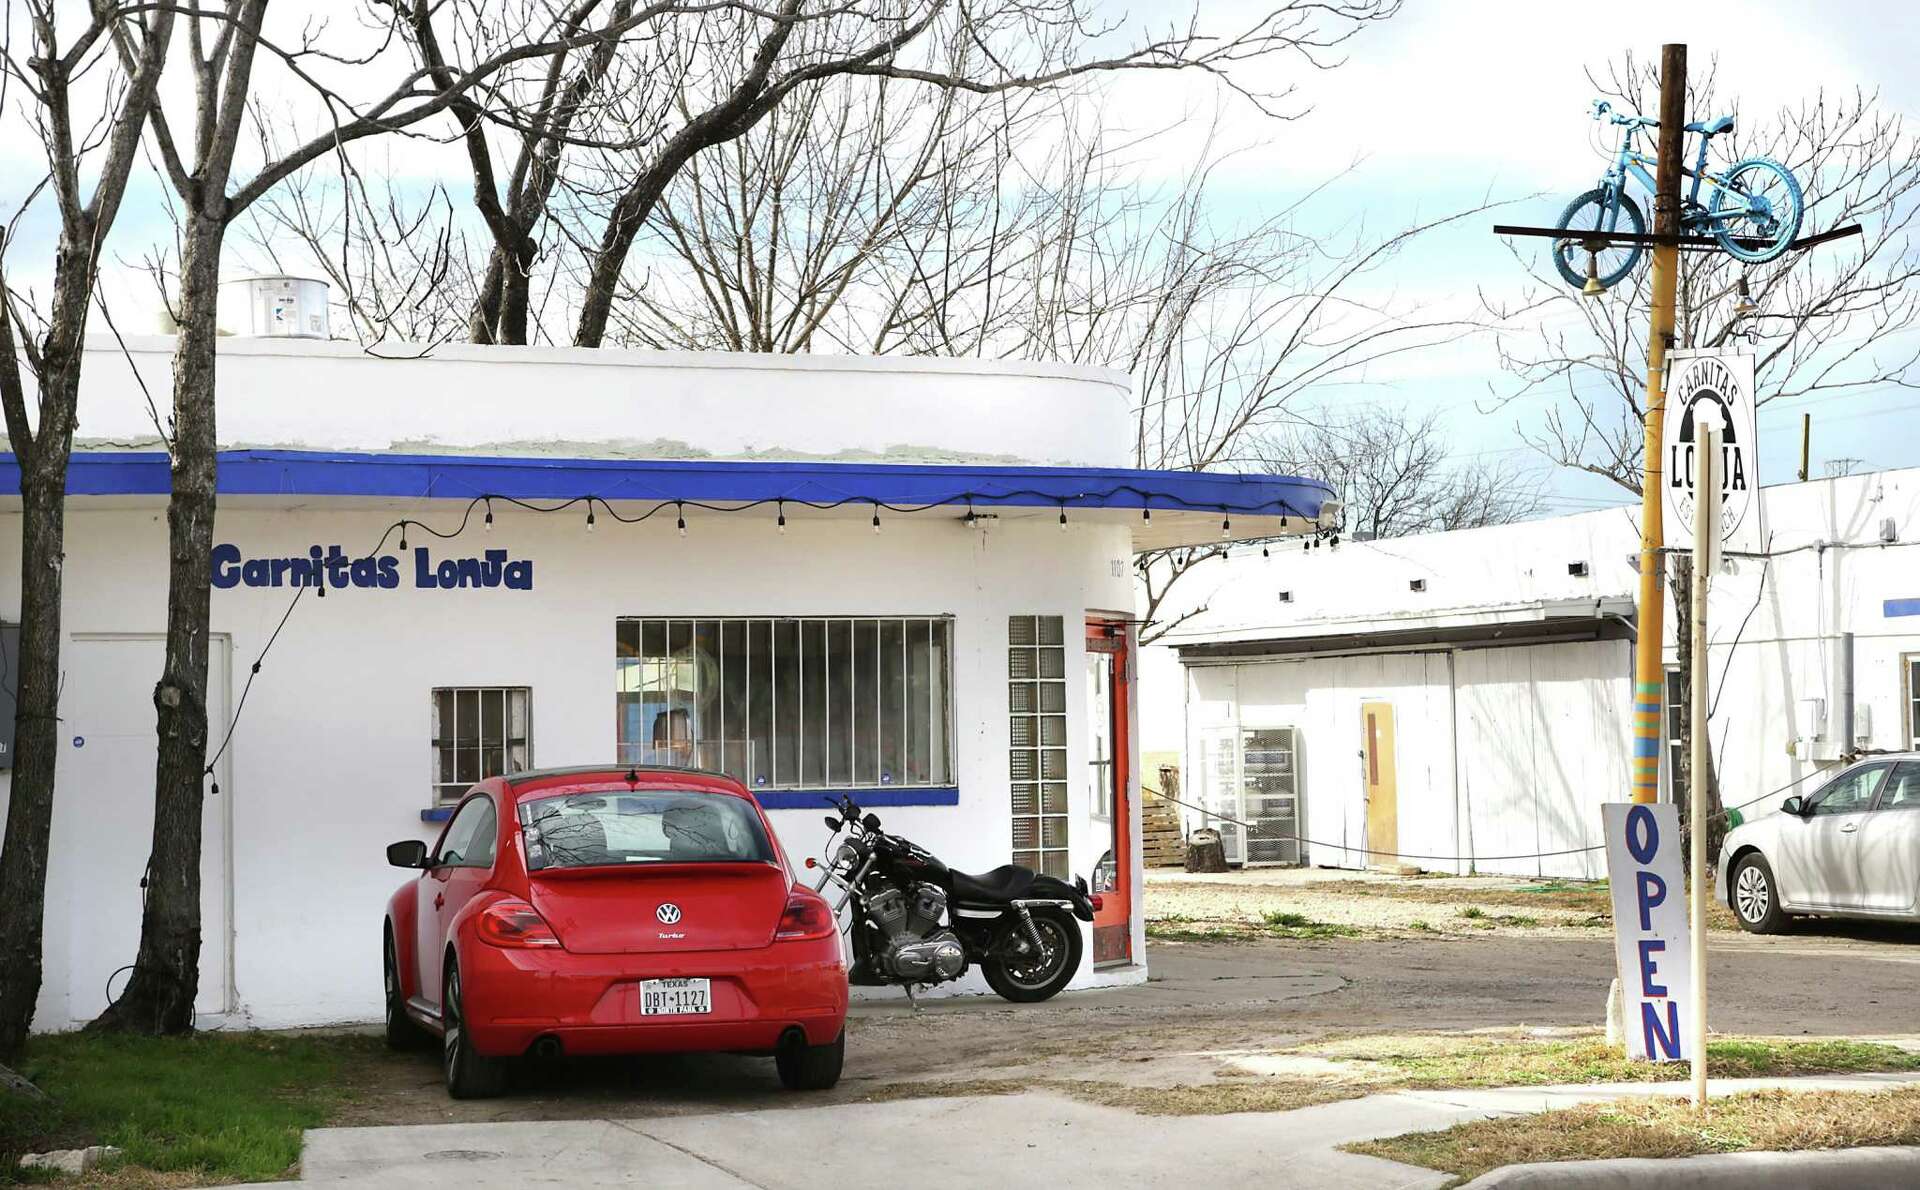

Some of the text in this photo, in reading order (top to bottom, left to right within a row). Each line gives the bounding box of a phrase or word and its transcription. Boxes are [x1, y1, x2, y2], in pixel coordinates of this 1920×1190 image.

[1678, 361, 1738, 406] CARNITAS
[1672, 445, 1746, 490] LOJA
[1625, 805, 1681, 1060] OPEN
[662, 980, 688, 988] TEXAS
